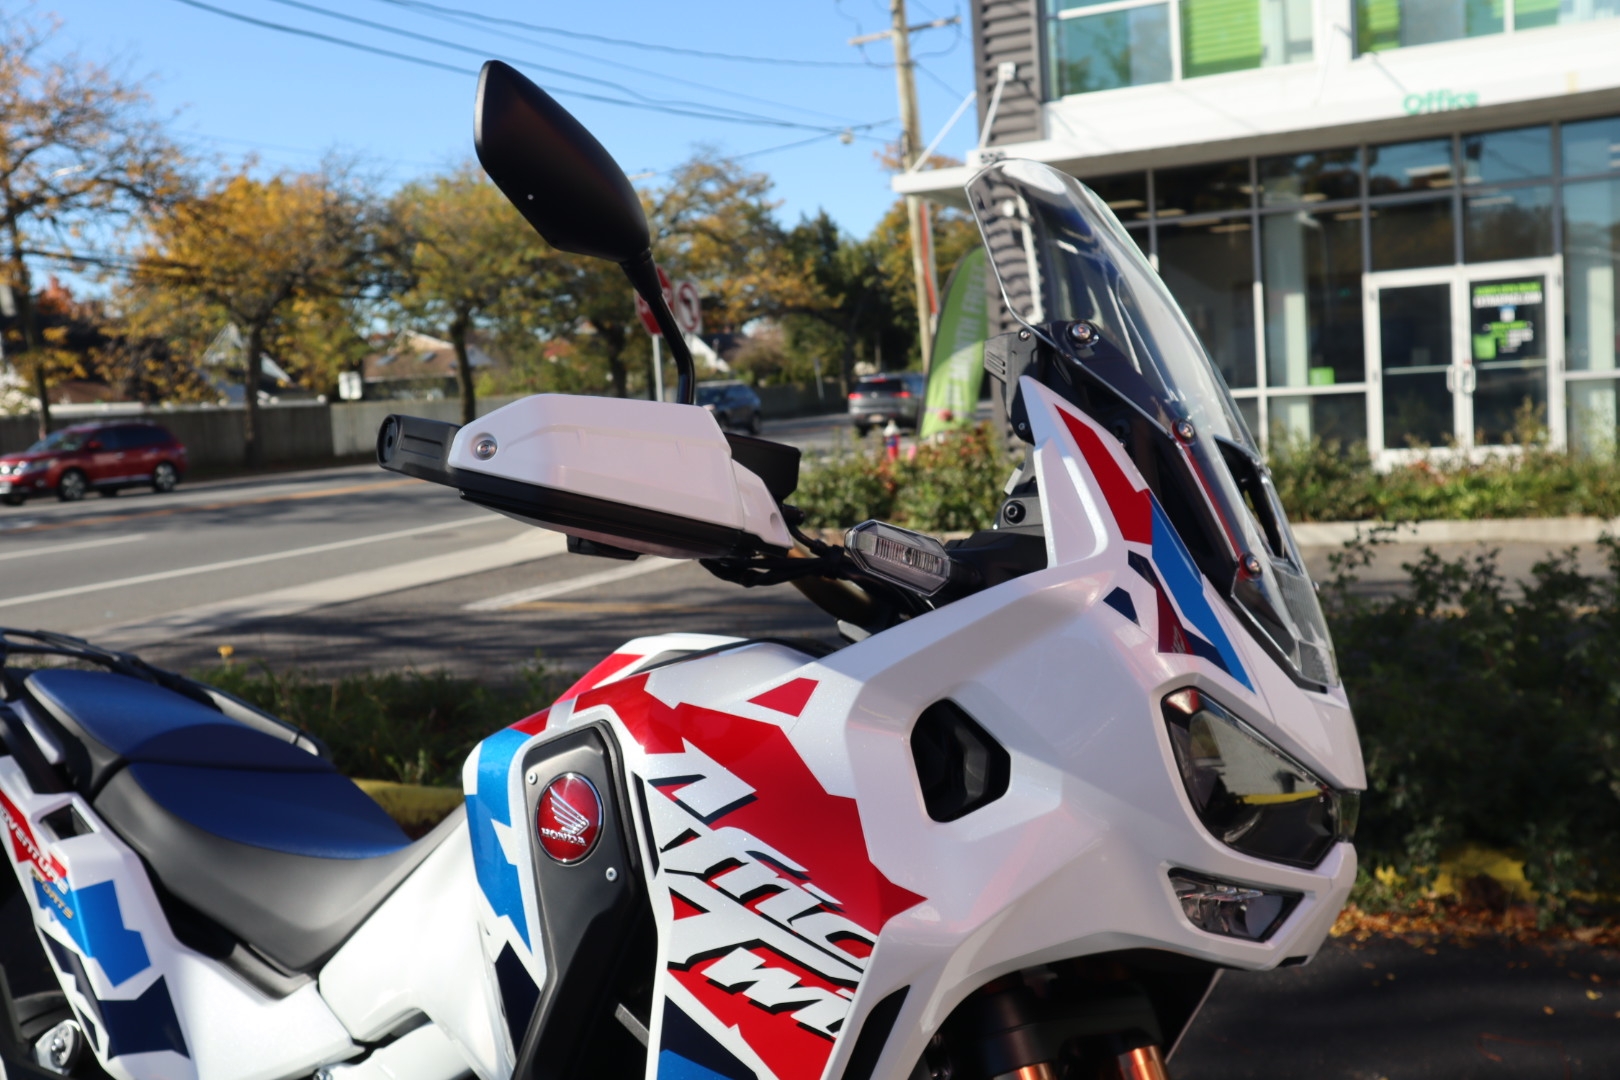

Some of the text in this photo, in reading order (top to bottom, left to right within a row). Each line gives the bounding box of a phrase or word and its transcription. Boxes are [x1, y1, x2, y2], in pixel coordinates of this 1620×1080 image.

[1403, 89, 1478, 115] Office
[541, 827, 587, 846] HONDA
[30, 868, 74, 919] SPORTS
